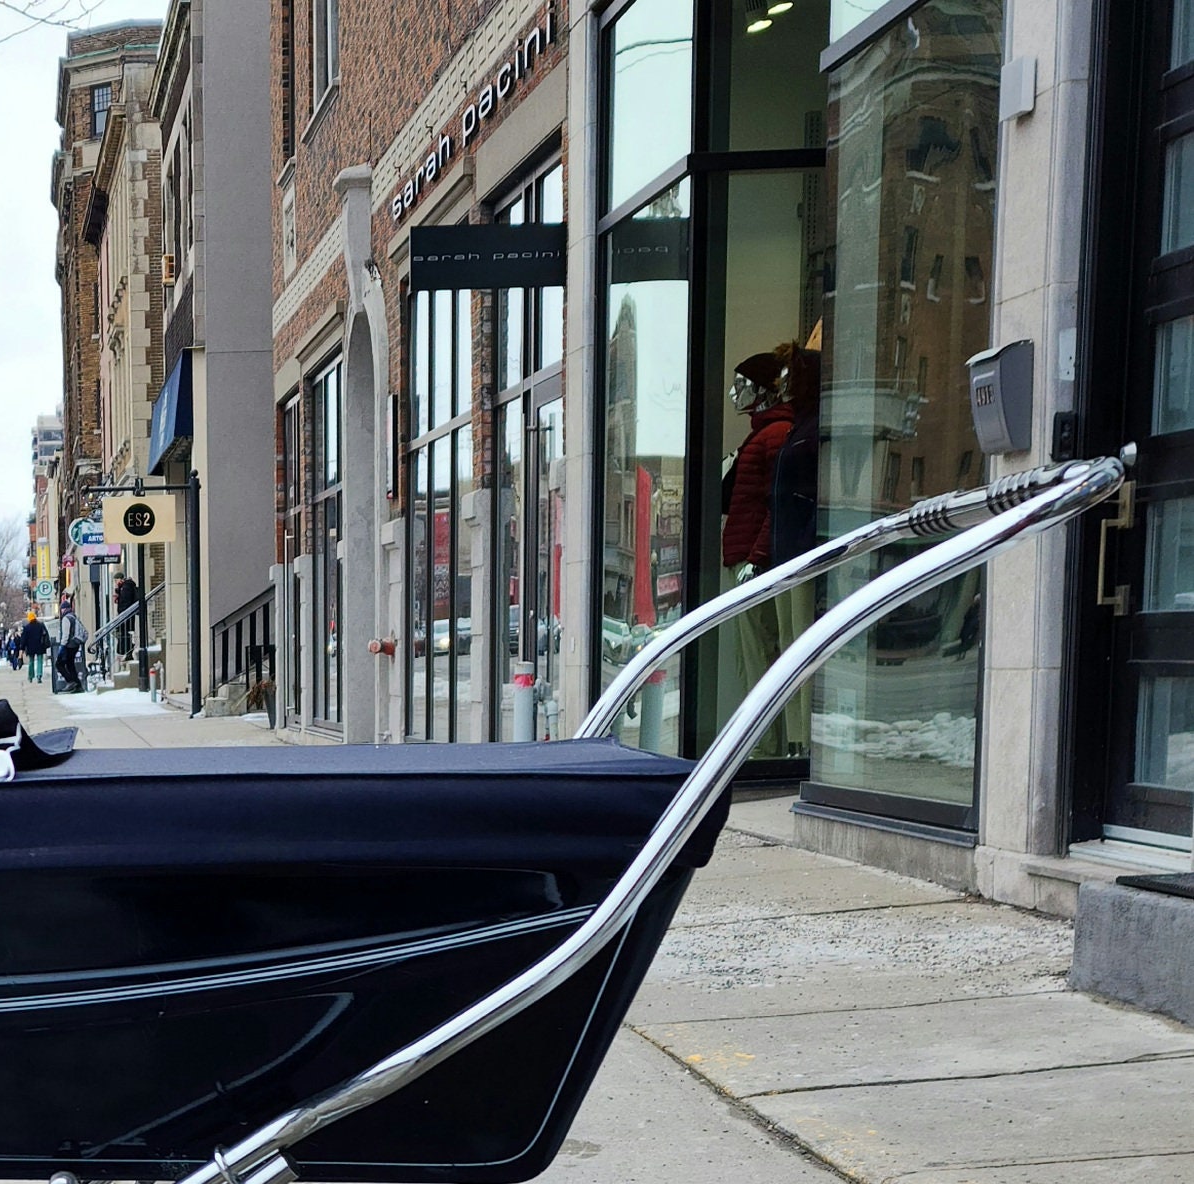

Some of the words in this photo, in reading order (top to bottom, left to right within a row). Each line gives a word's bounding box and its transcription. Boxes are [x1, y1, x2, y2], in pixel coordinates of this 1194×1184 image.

[393, 133, 450, 220] sarah
[462, 0, 552, 148] pacini
[413, 252, 480, 262] sarah
[493, 250, 560, 260] pacini
[128, 512, 151, 527] ES2
